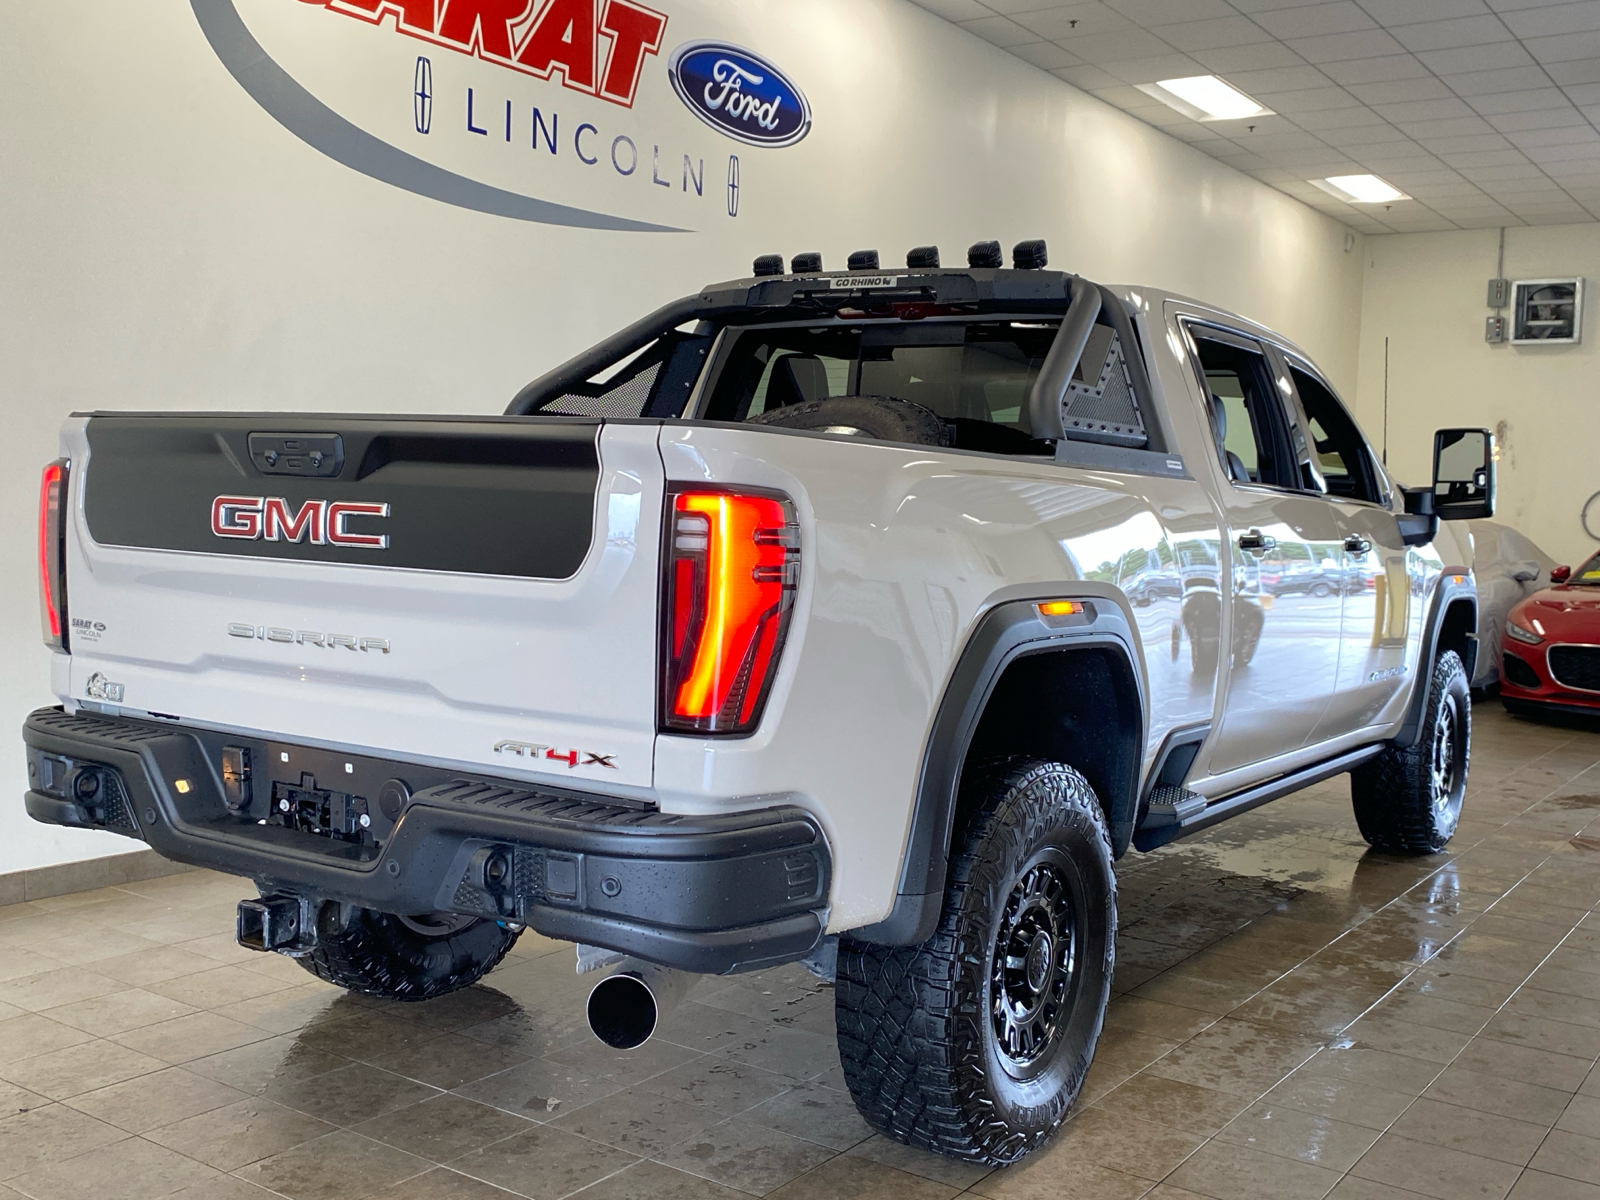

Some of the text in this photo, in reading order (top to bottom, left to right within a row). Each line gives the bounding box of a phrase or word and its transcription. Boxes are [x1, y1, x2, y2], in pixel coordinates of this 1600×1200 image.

[703, 59, 782, 131] Ford
[467, 87, 704, 197] LINCOLN
[211, 494, 391, 549] GMC
[71, 617, 93, 630] SARAT
[75, 628, 102, 638] LINCOLN
[227, 622, 391, 653] SIERRA
[493, 739, 620, 770] AT4X
